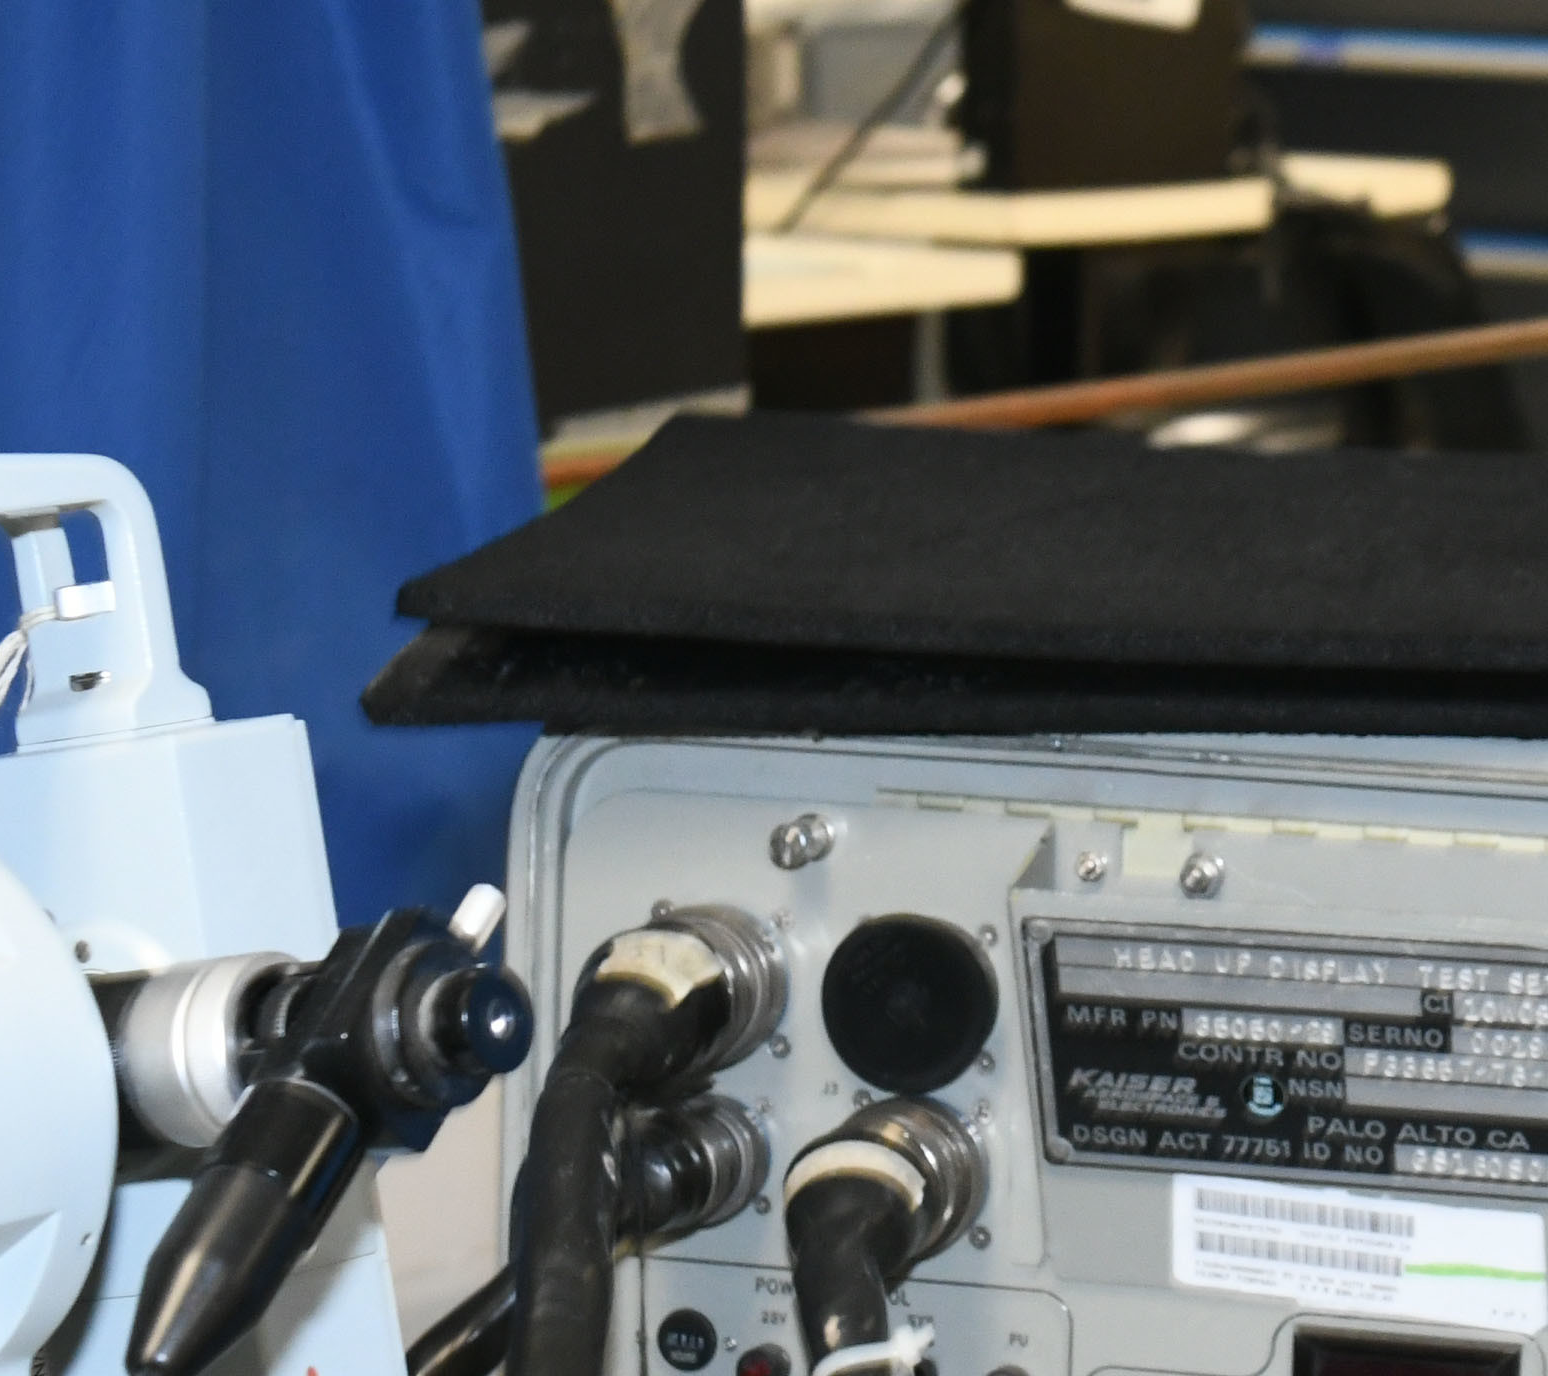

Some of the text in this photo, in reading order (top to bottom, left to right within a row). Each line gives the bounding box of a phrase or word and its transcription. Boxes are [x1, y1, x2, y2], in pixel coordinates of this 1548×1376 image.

[1114, 946, 1196, 972] HEAD
[1214, 952, 1252, 974] UP
[1268, 955, 1389, 985] DISPLAY
[1418, 965, 1490, 991] TEST
[1067, 1005, 1127, 1026] MFR
[1142, 1010, 1178, 1030] PN
[1351, 1024, 1444, 1047] SERNO
[1178, 1043, 1284, 1066] CONTR
[1297, 1050, 1342, 1070] NO
[1068, 1067, 1198, 1094] KAISER
[1288, 1078, 1343, 1099] NSN
[1072, 1125, 1147, 1147] DSGN
[1159, 1131, 1211, 1151] ACT
[1305, 1142, 1330, 1161] ID
[1344, 1145, 1383, 1165] NO
[1308, 1116, 1386, 1139] PALO
[1398, 1123, 1476, 1147] ALTO
[1488, 1130, 1530, 1151] CA
